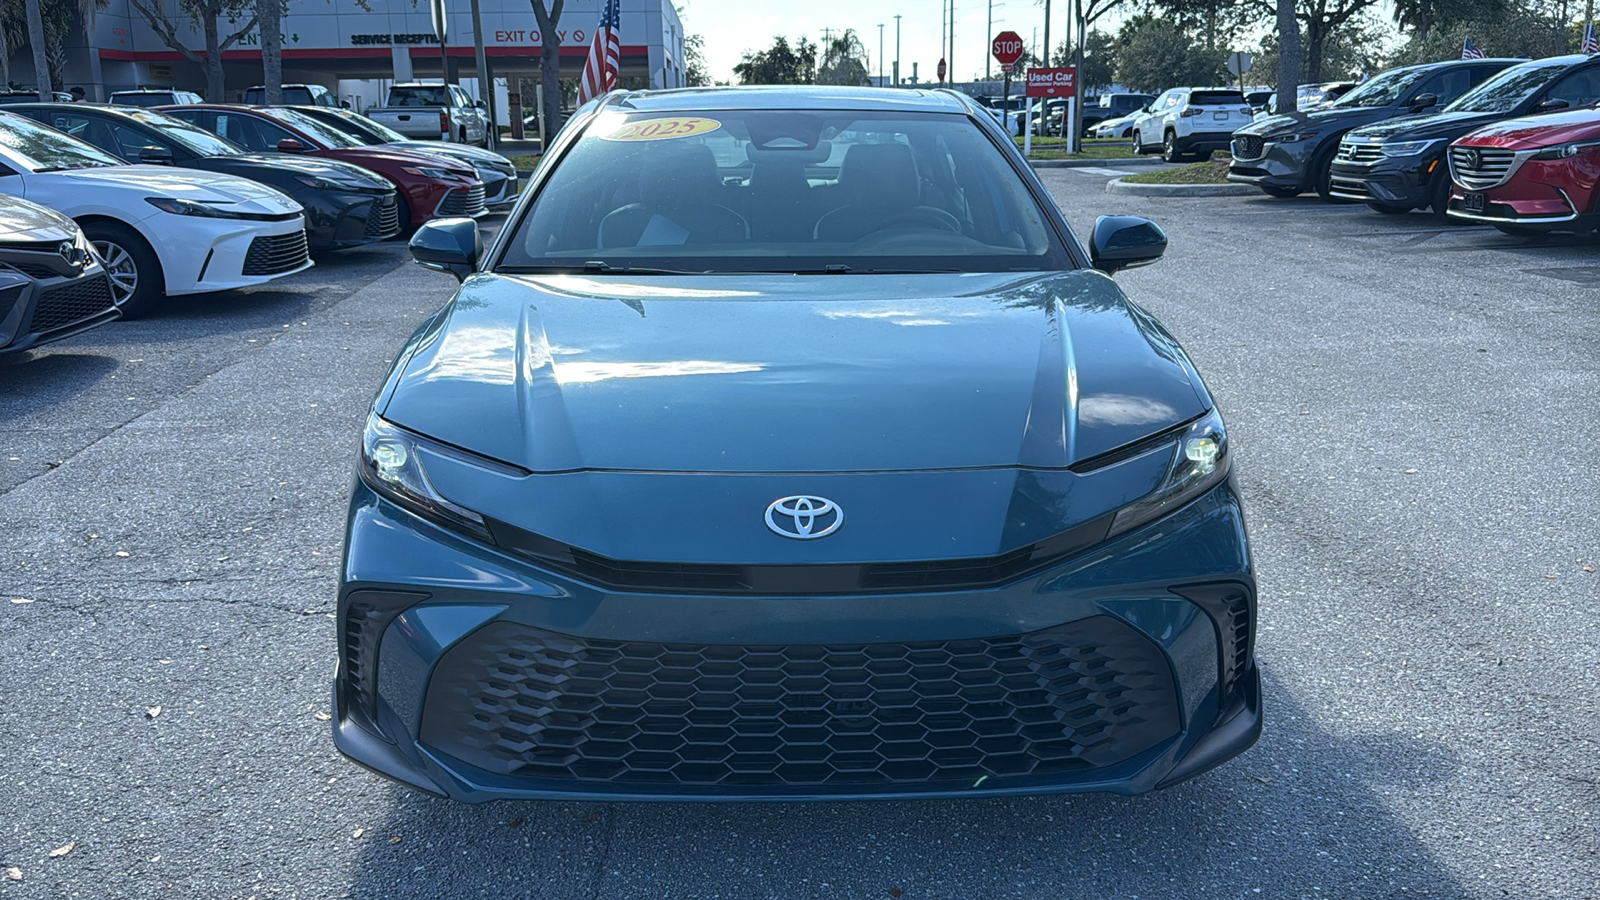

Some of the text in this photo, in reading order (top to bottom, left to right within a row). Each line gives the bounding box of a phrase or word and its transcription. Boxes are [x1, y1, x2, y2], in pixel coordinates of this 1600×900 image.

[238, 33, 287, 46] ENR
[350, 33, 448, 45] SERVICE RECEPTI
[495, 30, 568, 42] EXIT OY
[994, 41, 1021, 54] STOP
[1028, 72, 1073, 82] Used Car
[617, 120, 700, 139] 2025
